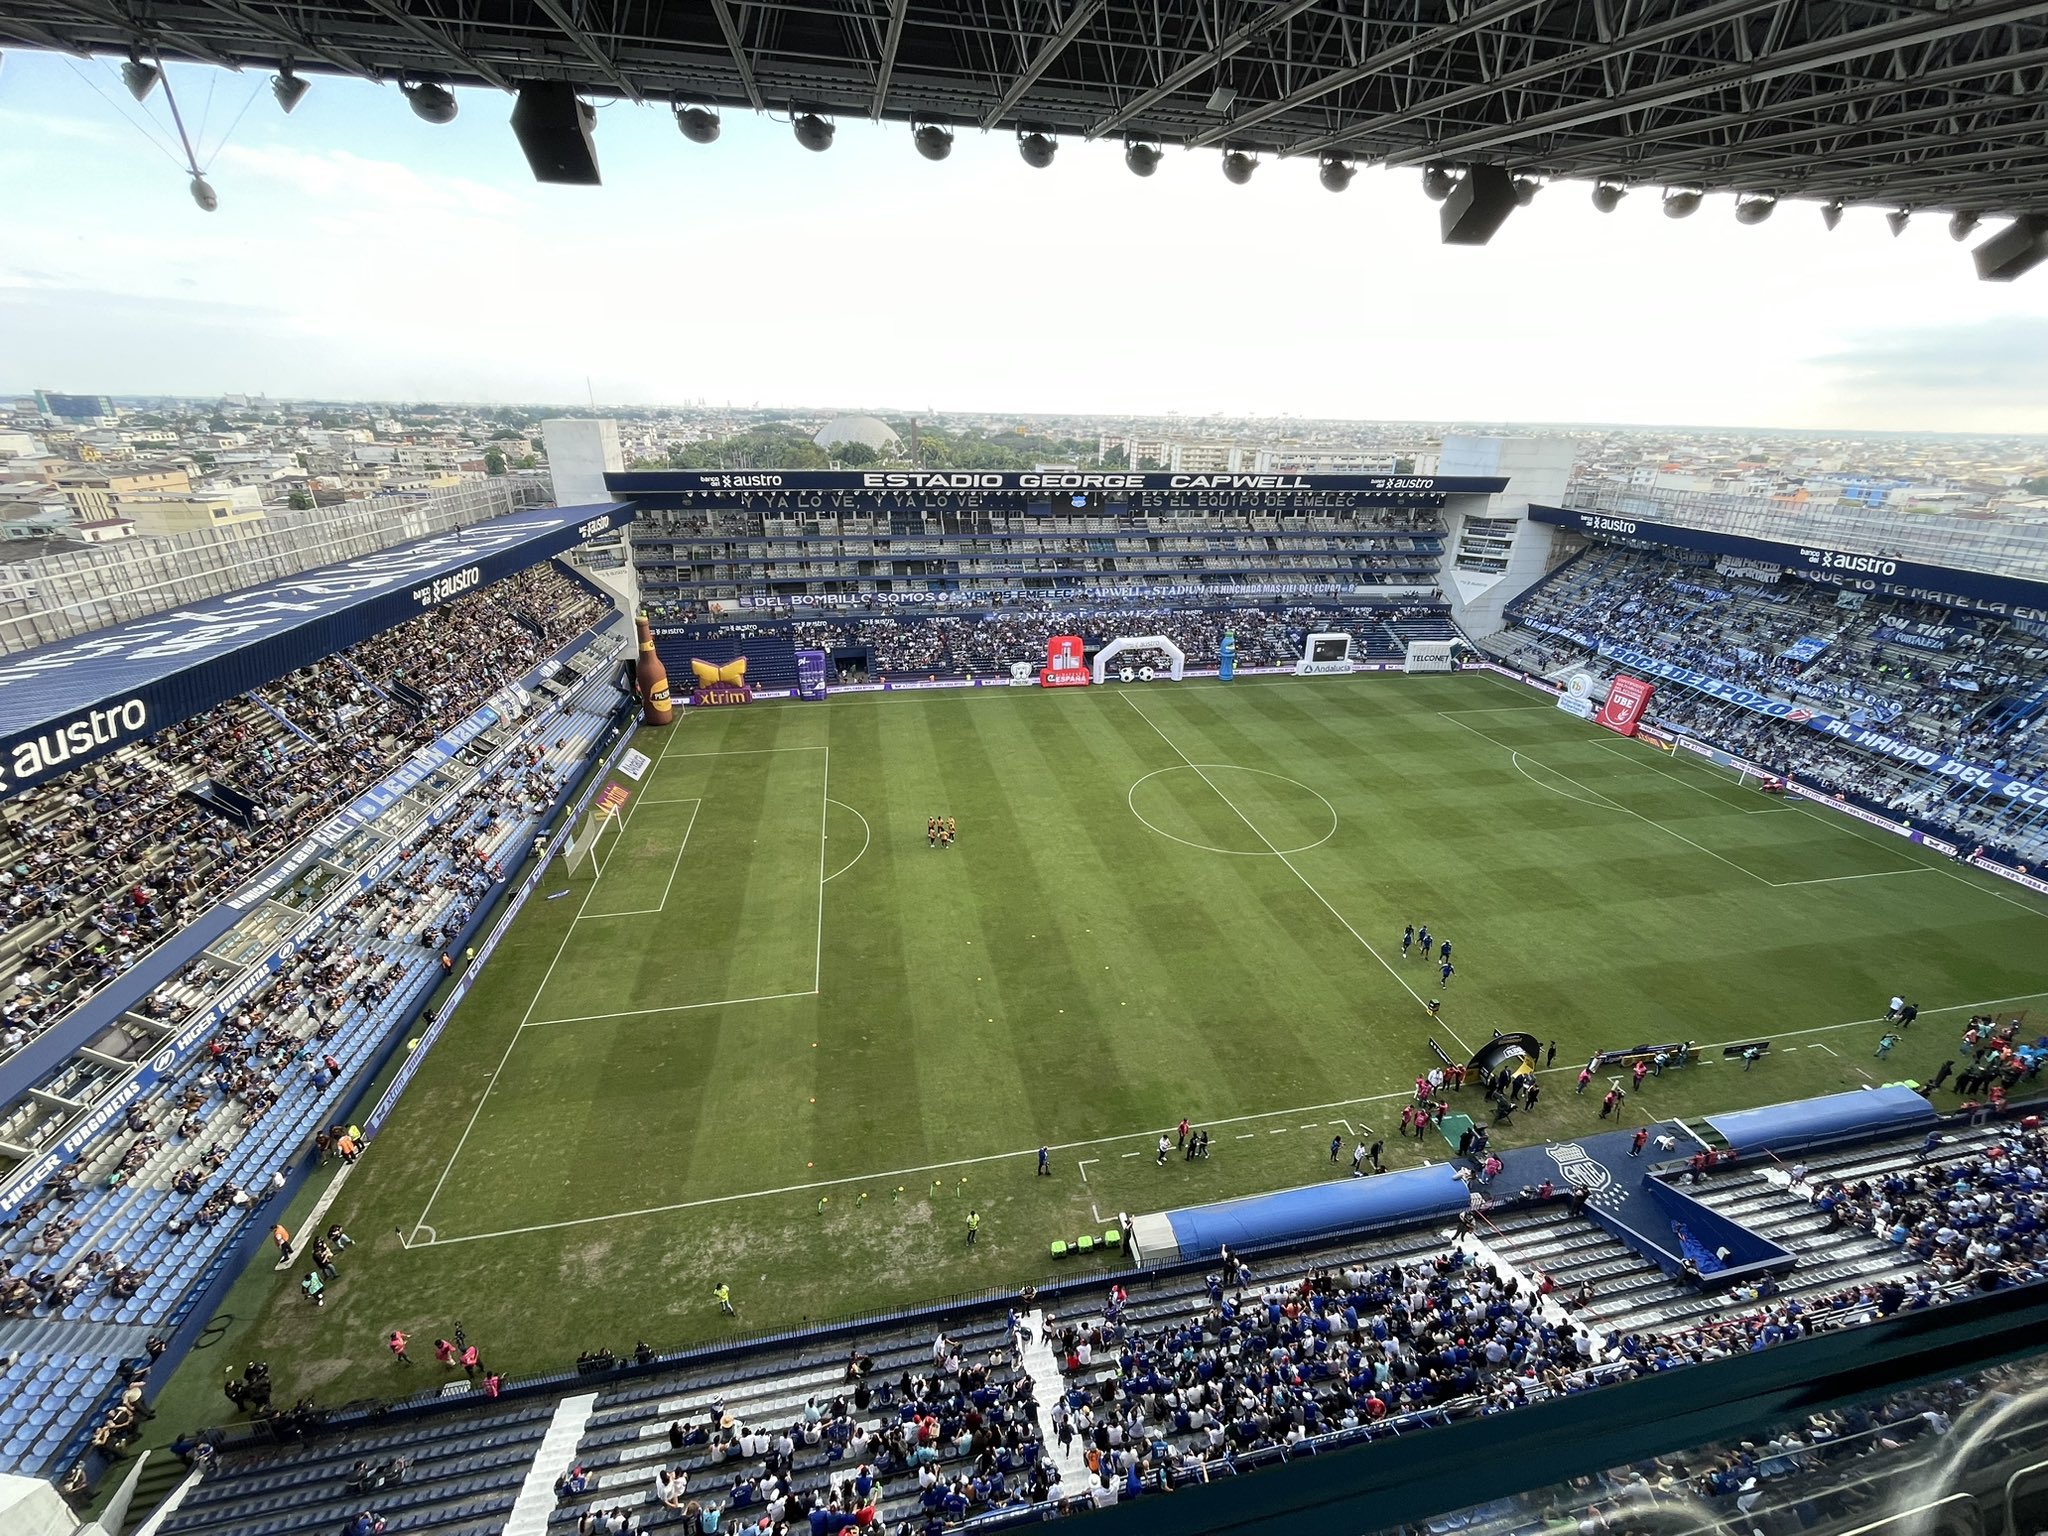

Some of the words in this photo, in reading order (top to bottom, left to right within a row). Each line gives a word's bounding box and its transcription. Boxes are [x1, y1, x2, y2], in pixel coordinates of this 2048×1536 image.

[734, 474, 782, 487] austro
[863, 474, 1003, 487] ESTADIO
[1019, 475, 1146, 488] GEORGE
[1170, 476, 1312, 489] CAPWELL
[1395, 478, 1434, 489] austro
[744, 496, 754, 508] Y
[764, 496, 789, 508] YA
[798, 496, 822, 508] LO
[831, 496, 860, 509] VE,
[874, 496, 883, 507] Y
[894, 496, 916, 507] YA
[925, 496, 948, 507] LO
[957, 496, 979, 507] VE
[1142, 495, 1163, 507] ES
[1169, 495, 1191, 507] EL
[1198, 495, 1259, 507] EQUIPO
[1266, 496, 1286, 507] DE
[1293, 496, 1356, 507] EMELEC
[1600, 518, 1636, 534] austro
[1800, 548, 1820, 557] banco
[1808, 556, 1819, 564] del
[1834, 552, 1896, 576] austro
[441, 566, 479, 598] austro
[1220, 584, 1263, 594] HINCHADA
[1262, 584, 1281, 593] MAS
[964, 591, 1012, 600] VAMOS
[1017, 589, 1073, 599] EMELEC
[1084, 586, 1143, 597] CAPWELL
[1152, 585, 1205, 596] STADIUM
[1809, 570, 1843, 586] QUE
[1881, 583, 1907, 596] TE
[1911, 587, 1969, 608] MATE
[1976, 599, 2008, 614] LA
[2012, 606, 2048, 622] EN
[754, 596, 785, 607] DEL
[877, 592, 935, 602] SOMOS
[1055, 674, 1087, 683] ESPAÑA
[1608, 648, 1667, 678] BOCA
[1664, 667, 1713, 695] DEL
[1711, 681, 1794, 716] POZO
[700, 690, 745, 705] xtrim
[1613, 694, 1634, 709] UBE
[11, 699, 146, 778] austro
[1824, 719, 1853, 738] AL
[1856, 731, 1942, 767] MANDO
[1938, 759, 1994, 788] DEL
[2002, 780, 2048, 808] EC
[1975, 858, 2001, 873] NTERNET
[295, 915, 324, 945] HIGER
[177, 1012, 218, 1051] HIGER
[218, 963, 271, 1014] FURGONETAS
[385, 1077, 406, 1104] xtrim
[0, 1153, 63, 1212] HIGER
[63, 1080, 141, 1154] FURGONETAS
